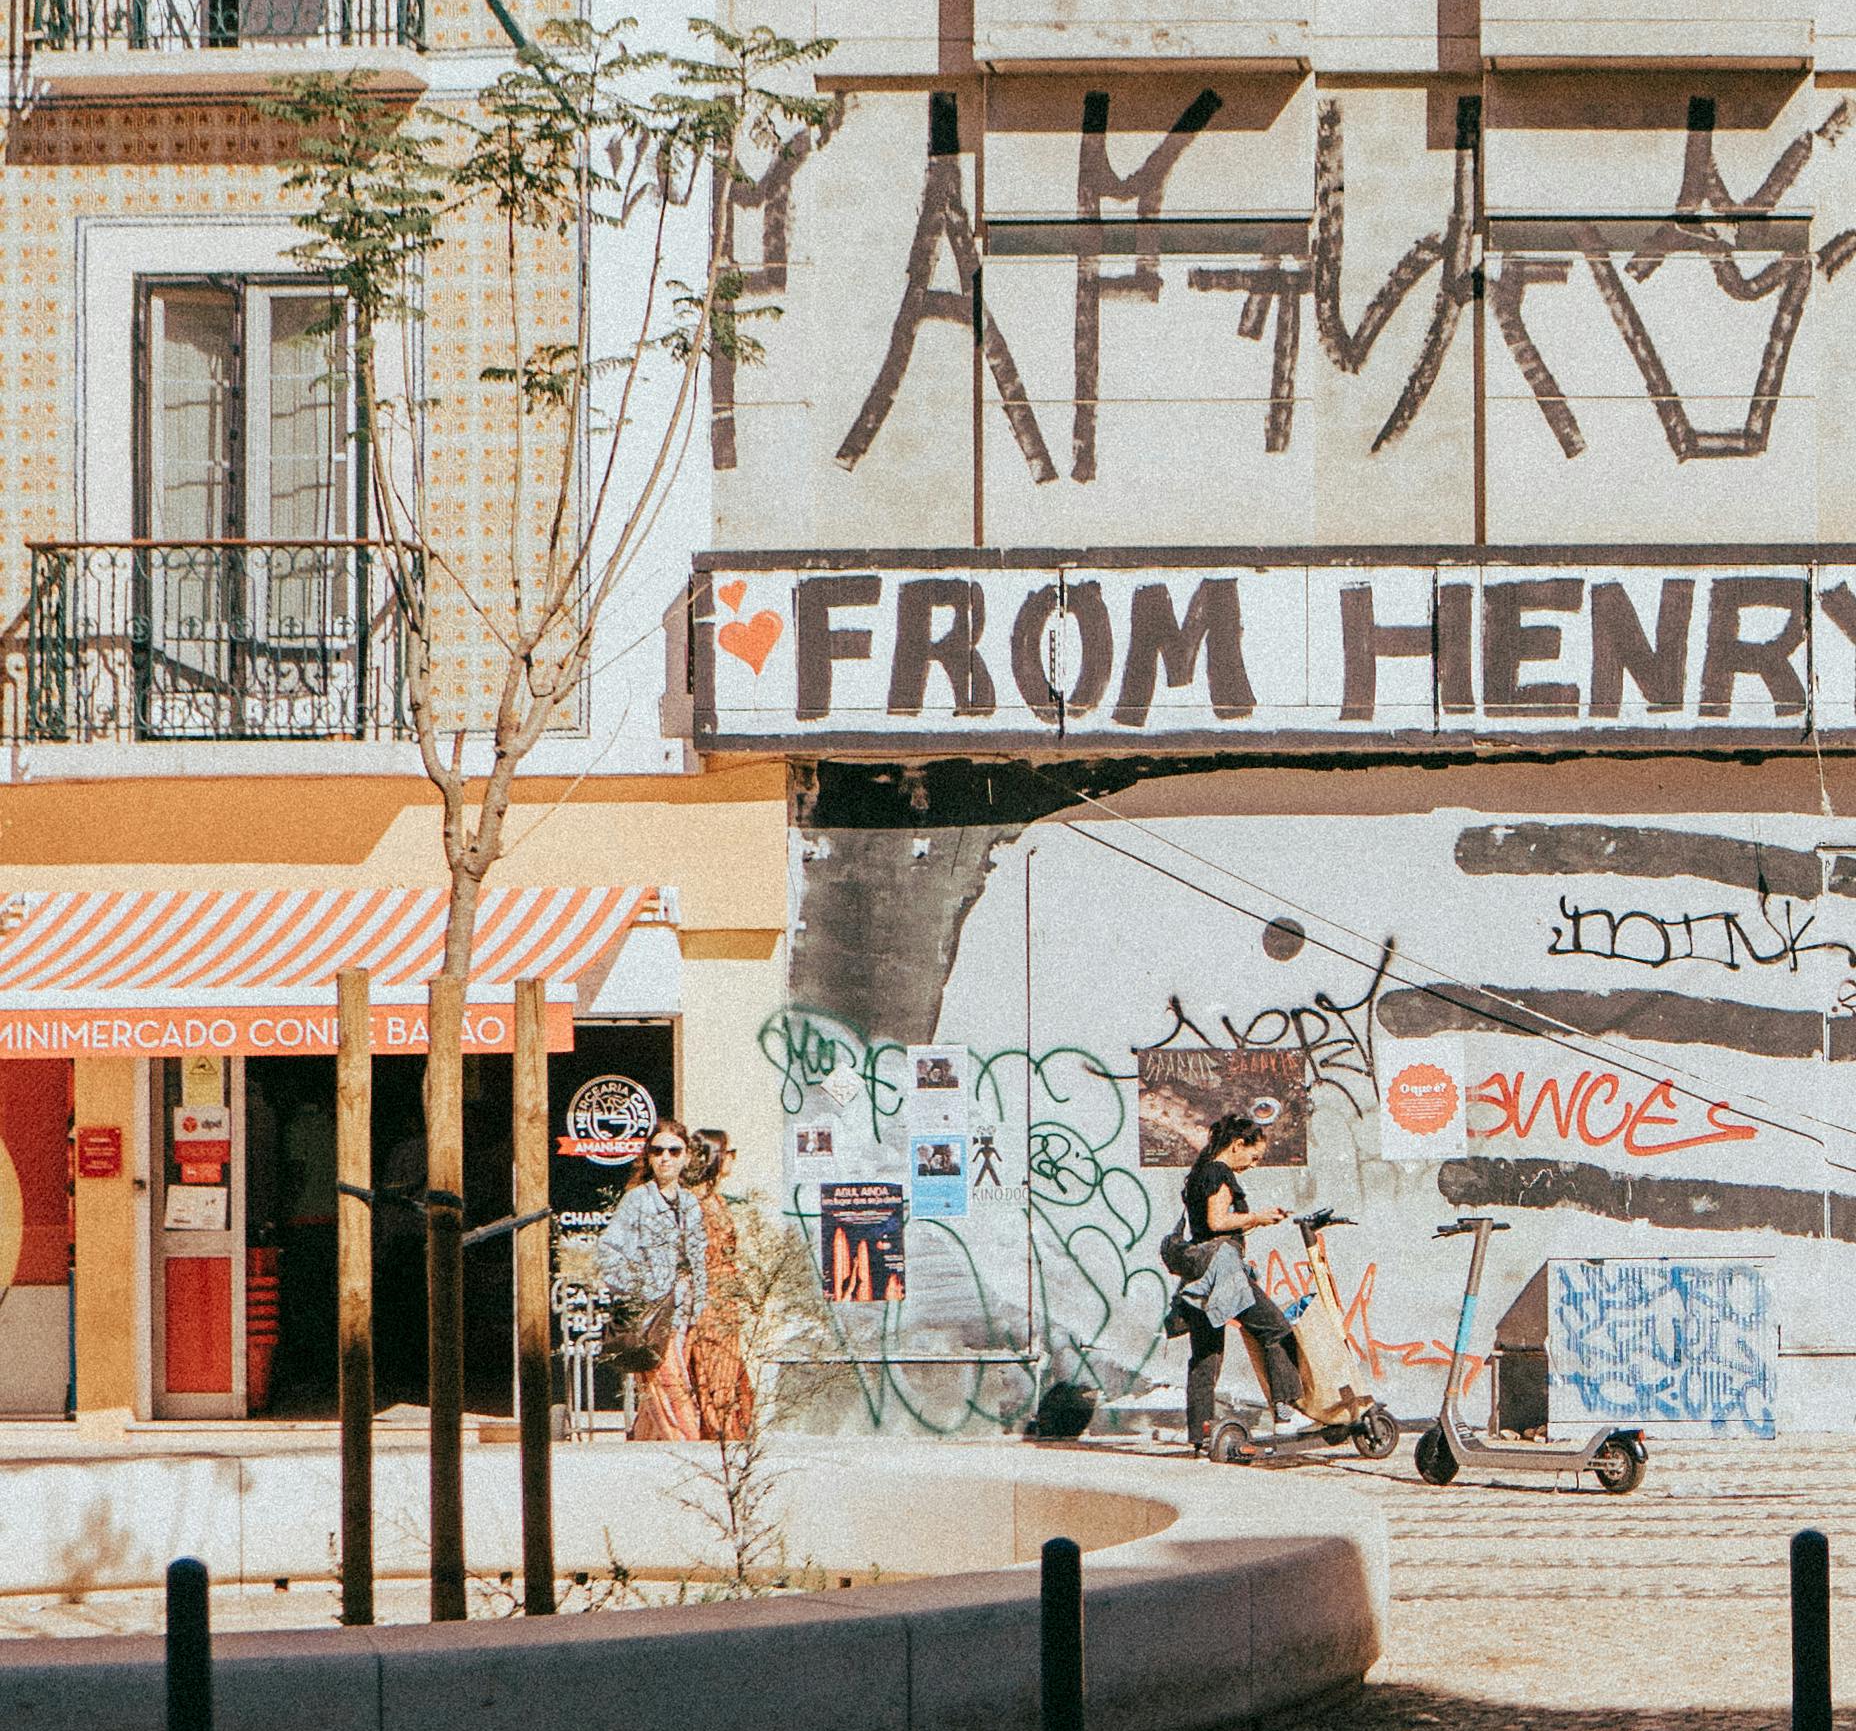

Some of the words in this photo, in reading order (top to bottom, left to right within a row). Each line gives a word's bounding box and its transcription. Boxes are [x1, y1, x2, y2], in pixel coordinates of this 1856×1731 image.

[792, 575, 1257, 726] FROM
[248, 1017, 376, 1048] CON
[387, 1010, 506, 1047] BAÃO
[575, 1083, 630, 1129] MERCEARIA
[1410, 1084, 1433, 1097] que
[575, 1141, 648, 1154] AMANHECE
